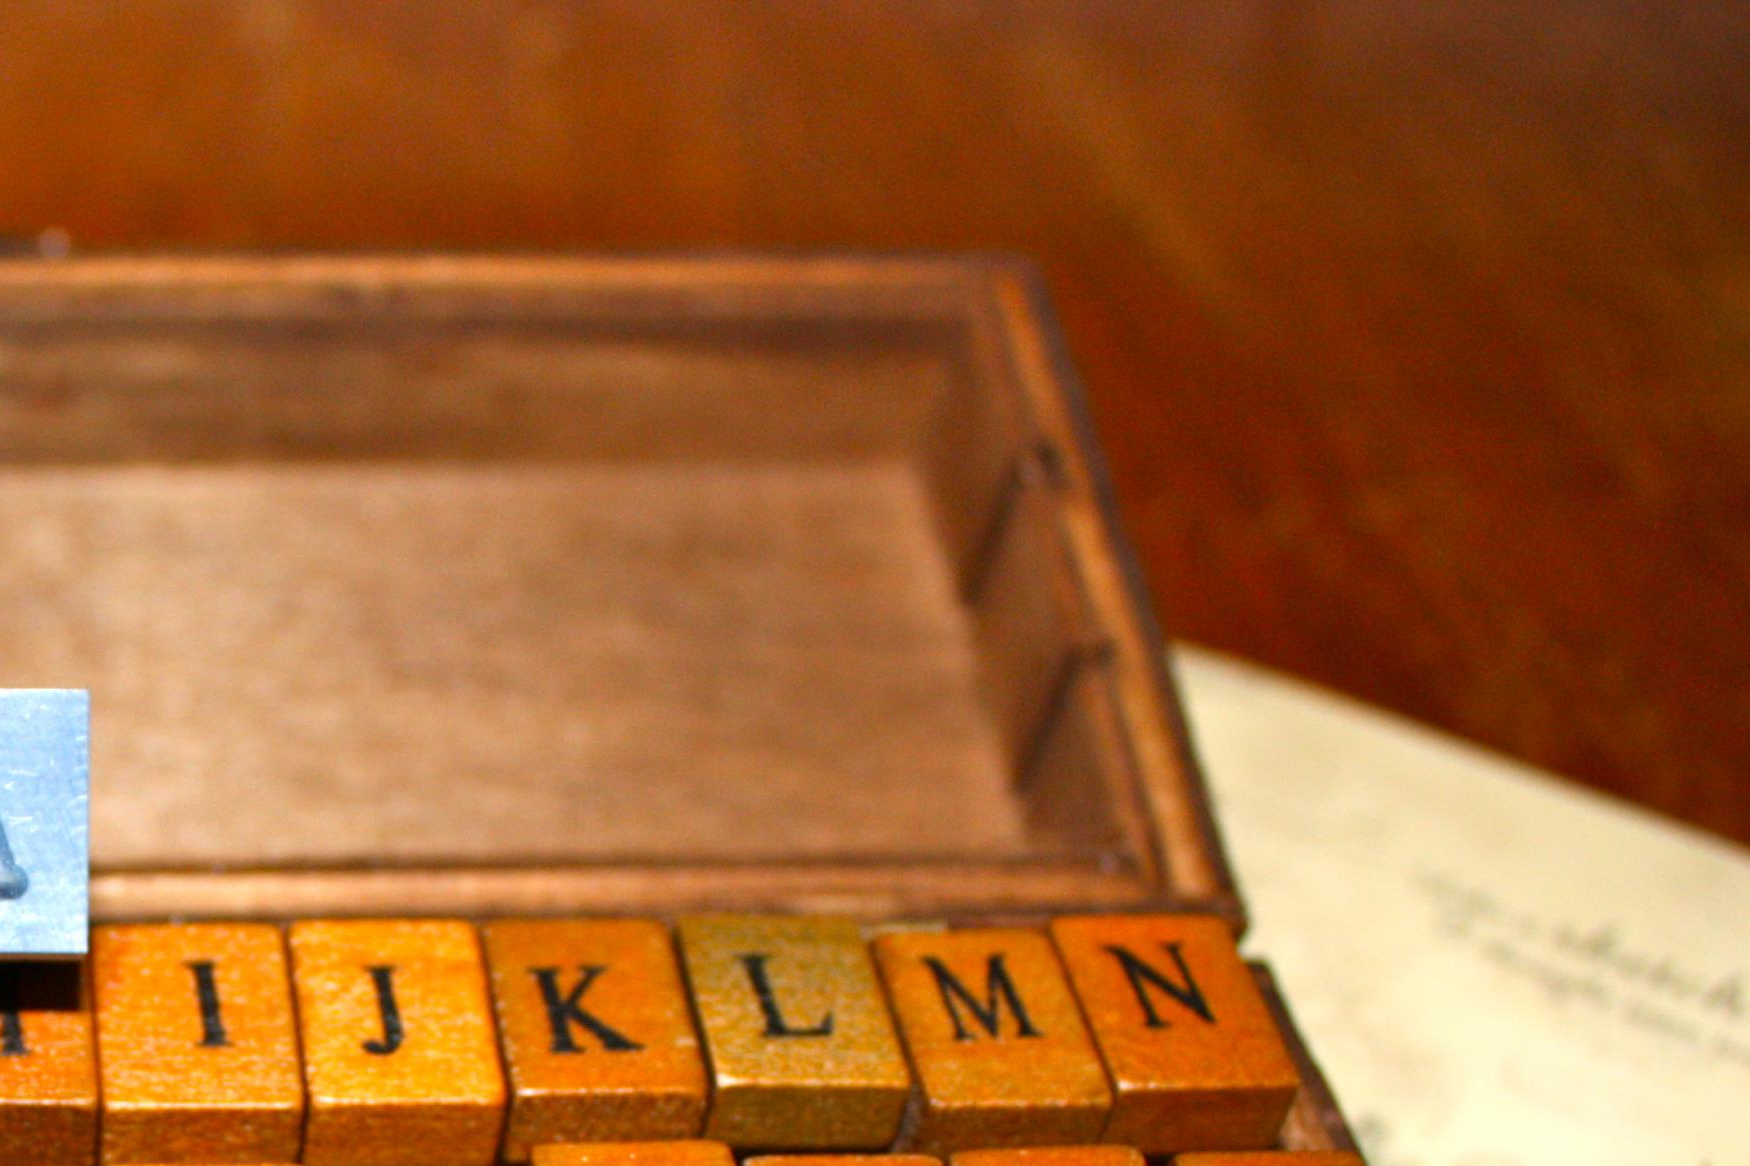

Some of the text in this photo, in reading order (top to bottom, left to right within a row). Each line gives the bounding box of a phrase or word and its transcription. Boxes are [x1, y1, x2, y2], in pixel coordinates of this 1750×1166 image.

[182, 959, 233, 1047] I
[359, 963, 406, 1057] J
[532, 965, 642, 1054] K
[739, 952, 833, 1038] L
[919, 951, 1047, 1042] M
[1107, 943, 1215, 1029] N
